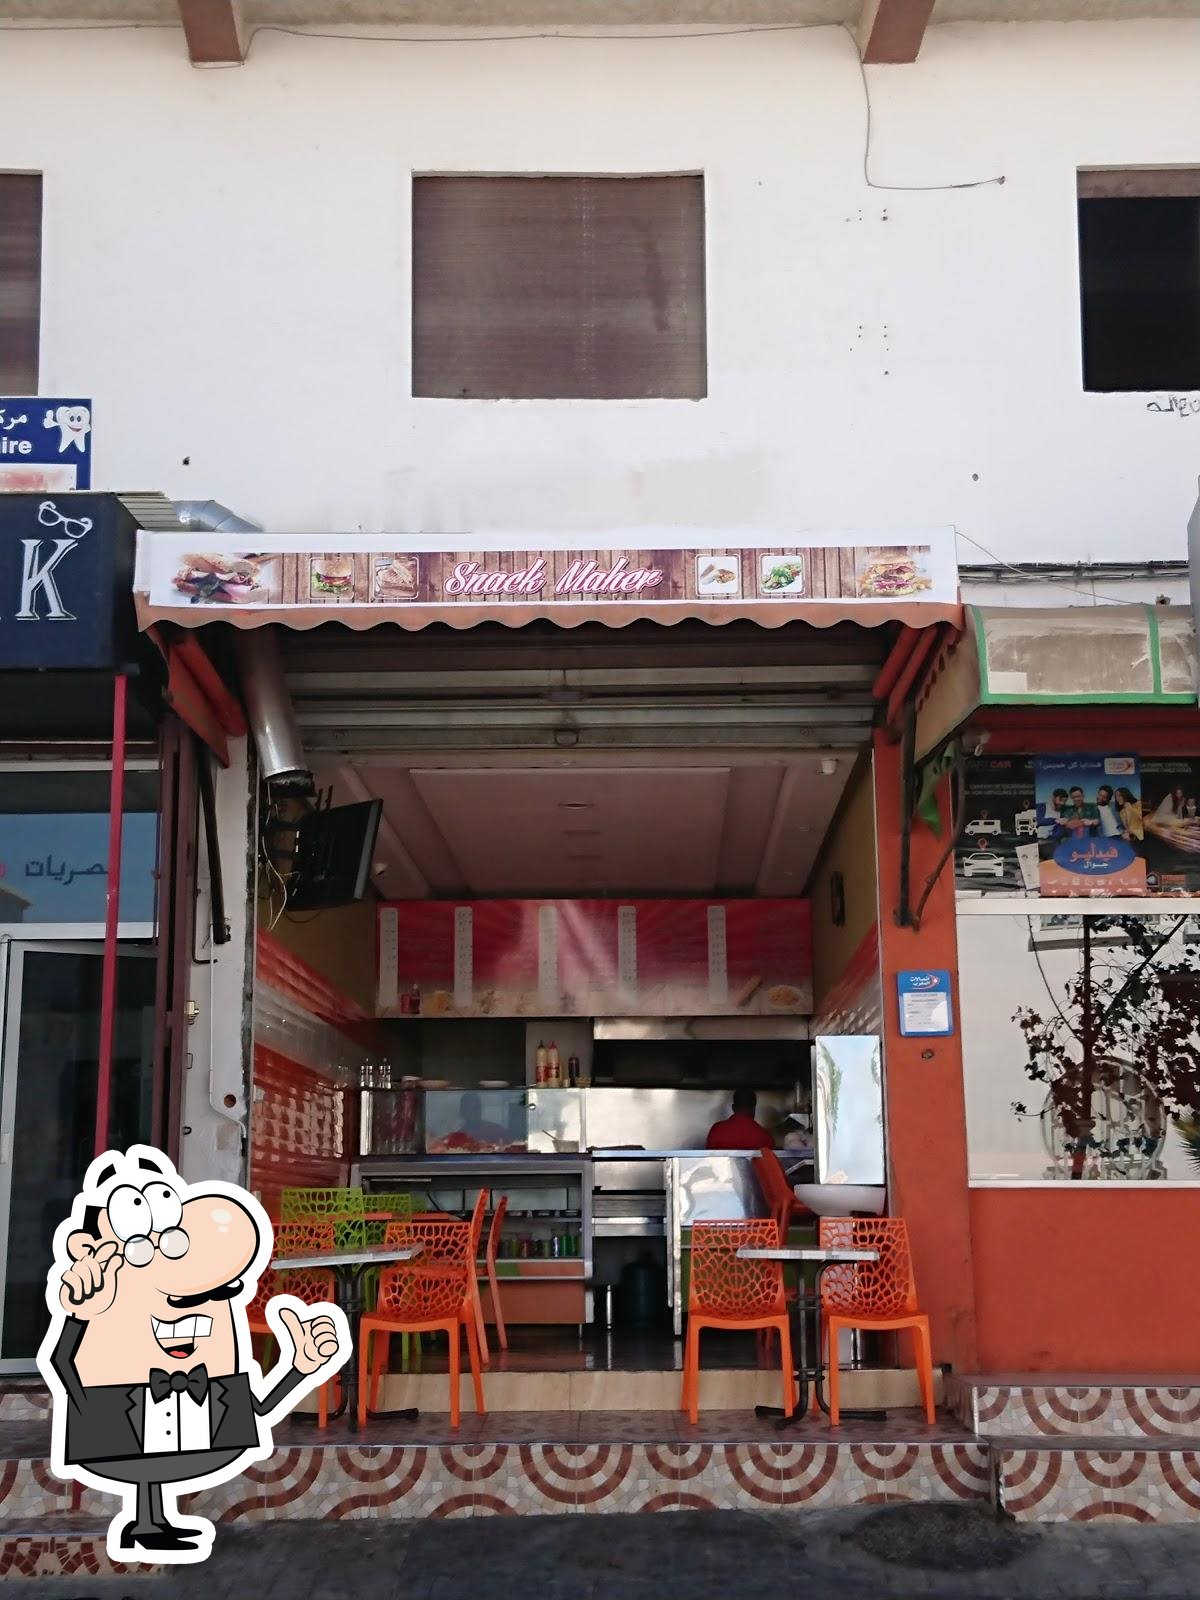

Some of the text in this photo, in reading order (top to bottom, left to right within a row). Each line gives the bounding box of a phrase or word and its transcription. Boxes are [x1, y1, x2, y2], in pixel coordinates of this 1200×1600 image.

[0, 436, 32, 454] ire
[15, 538, 79, 621] K
[444, 555, 663, 596] Snack Maher
[25, 854, 110, 886] صريات
